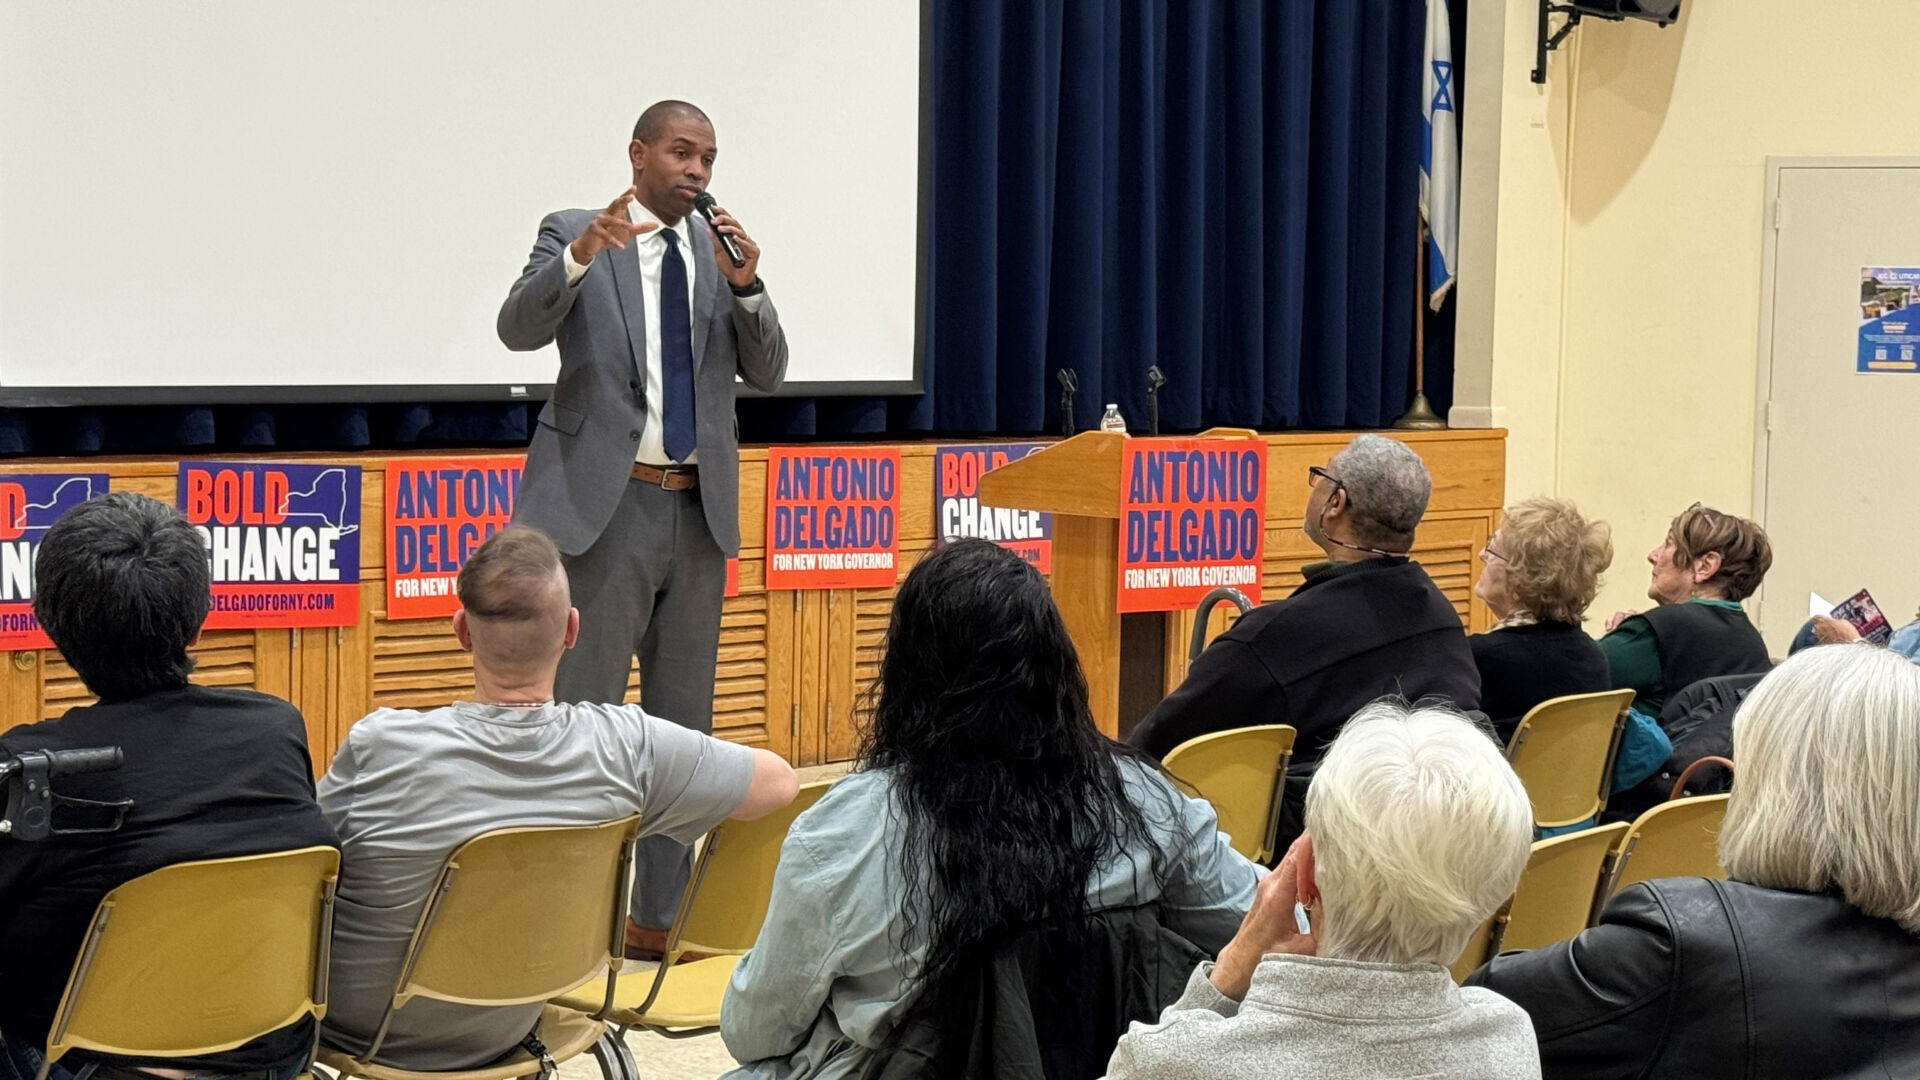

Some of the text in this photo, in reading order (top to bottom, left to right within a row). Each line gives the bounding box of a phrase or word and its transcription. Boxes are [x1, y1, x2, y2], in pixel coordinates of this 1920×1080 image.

[187, 469, 289, 525] BOLD
[395, 469, 521, 519] ANTONI
[776, 457, 894, 501] ANTONIO
[1128, 450, 1259, 503] ANTONIO
[774, 505, 894, 549] DELGADO
[942, 497, 1044, 544] CHANGE
[1126, 508, 1259, 564] DELGADO
[395, 523, 510, 575] DELG
[773, 552, 894, 571] FOR NEW YORK GOVERNOR
[395, 578, 420, 598] FOR
[420, 577, 449, 597] NEW
[1125, 565, 1257, 589] FOR NEW YORK GOVERNOR
